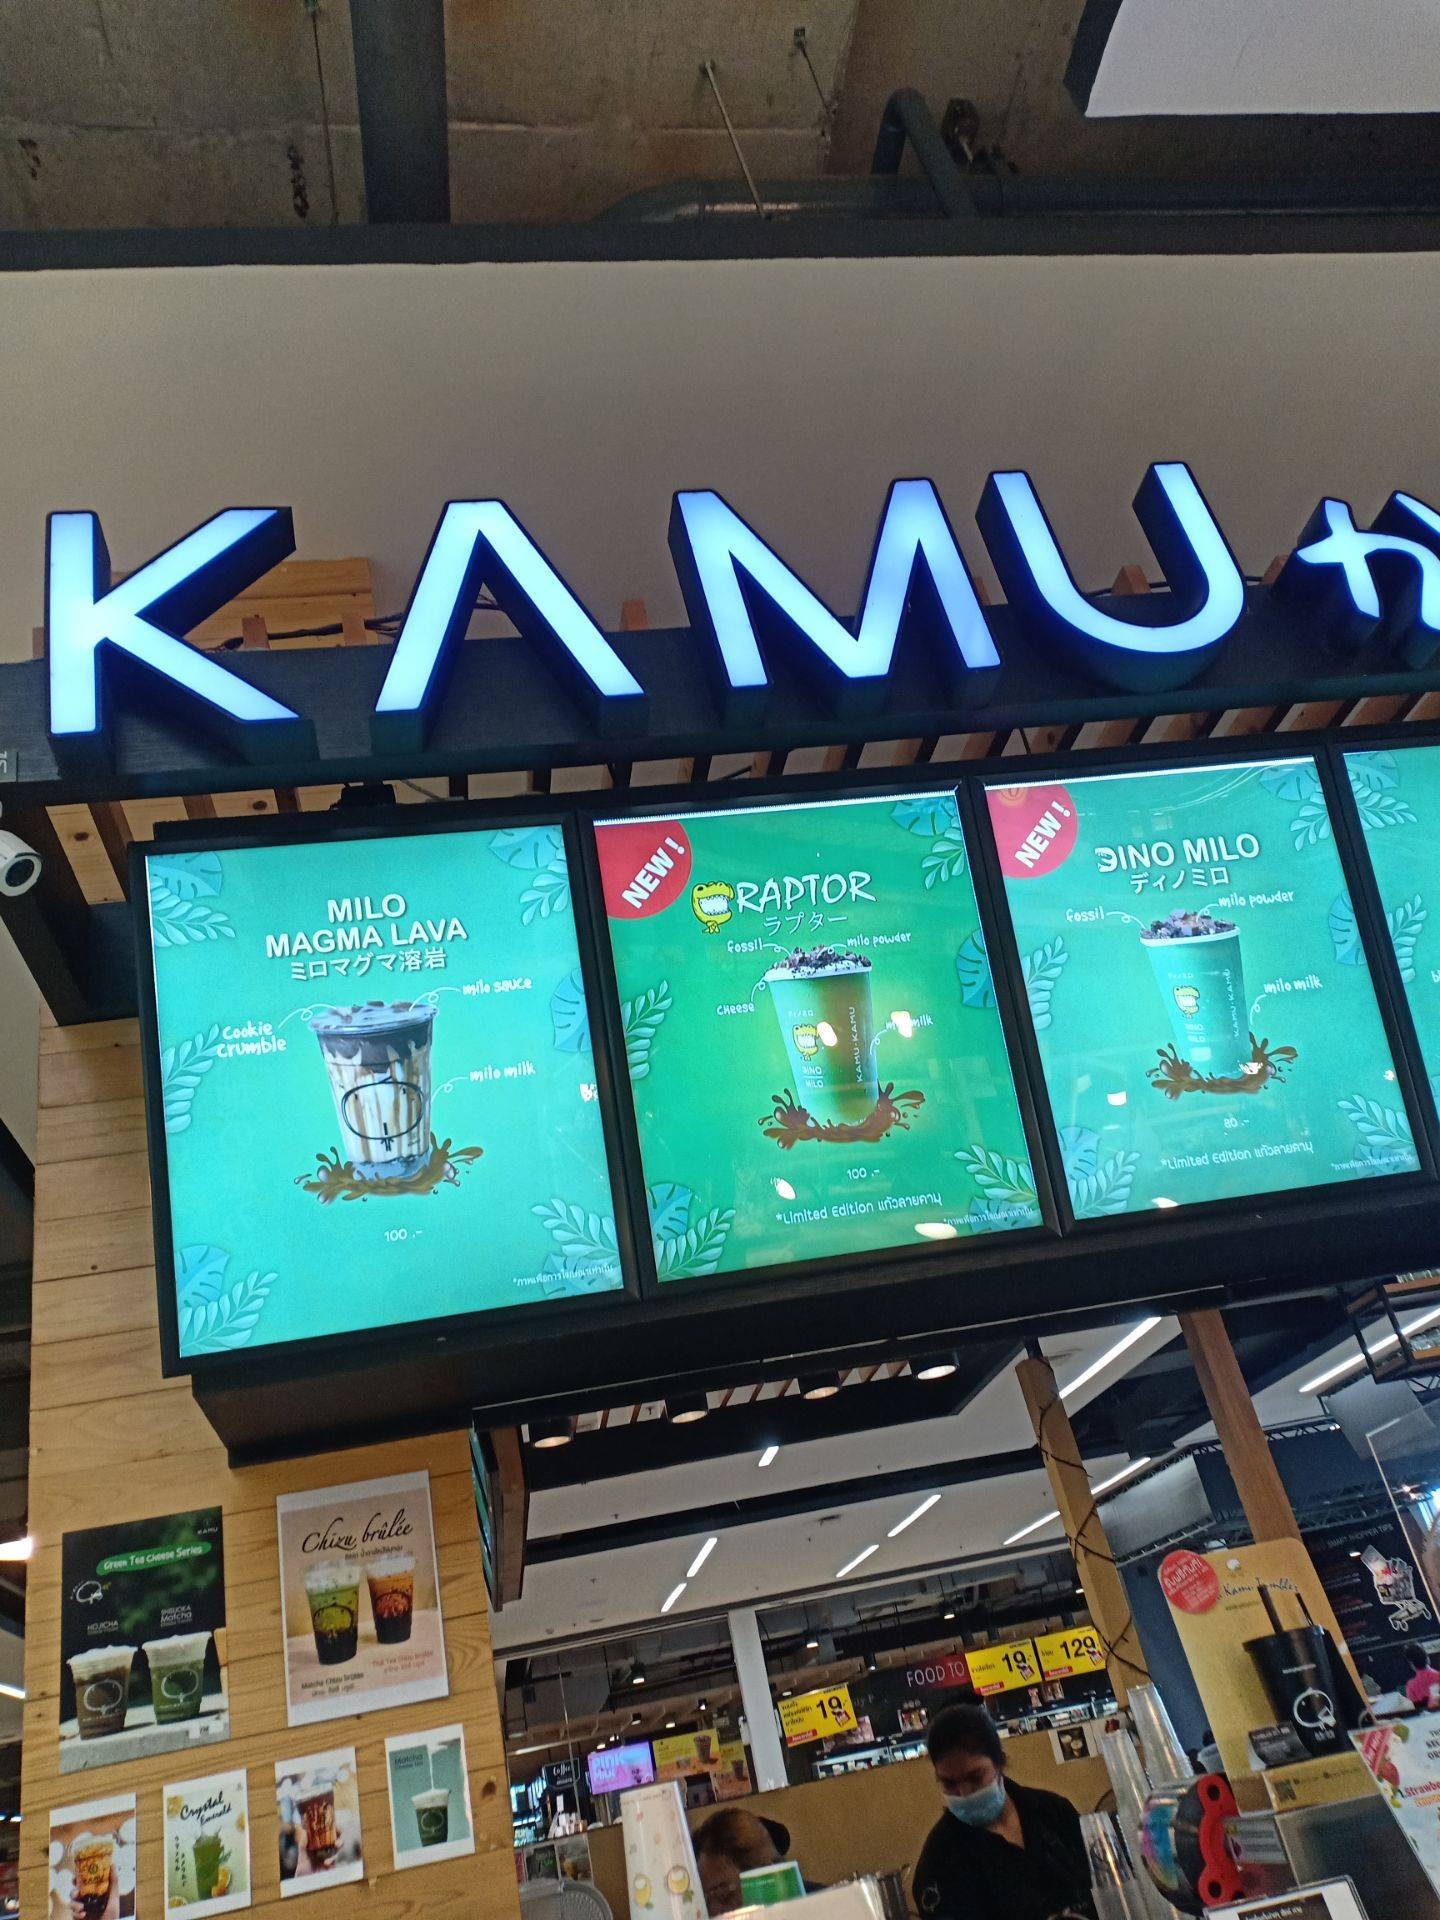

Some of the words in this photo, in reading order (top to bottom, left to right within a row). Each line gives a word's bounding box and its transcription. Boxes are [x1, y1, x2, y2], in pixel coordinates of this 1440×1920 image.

[47, 462, 1245, 735] KAMU
[1184, 833, 1260, 864] MILO
[1130, 866, 1230, 894] ディノミロ
[736, 871, 877, 914] RAPTOR
[1218, 892, 1246, 908] milo
[1249, 890, 1294, 906] powder
[327, 893, 406, 923] MILO
[763, 912, 848, 936] ラプター
[265, 925, 383, 958] MAGMA
[390, 917, 468, 946] LAVA
[873, 931, 912, 948] powder
[291, 947, 447, 981] ミロマグマ溶岩
[462, 981, 490, 996] milo
[494, 976, 533, 992] sauce
[1264, 978, 1292, 994] milo
[1293, 974, 1323, 990] milk
[469, 1066, 501, 1082] milo
[504, 1060, 536, 1077] milk
[1223, 1118, 1238, 1129] 80
[847, 1167, 867, 1181] 100
[384, 1228, 408, 1242] 100
[301, 1517, 357, 1553] Chizu
[130, 1554, 145, 1566] Tea
[176, 1545, 203, 1558] Series
[1060, 1636, 1096, 1660] 129
[1002, 1650, 1027, 1672] 19
[906, 1665, 946, 1688] FOOD
[949, 1660, 965, 1681] TO
[816, 1696, 843, 1719] 19
